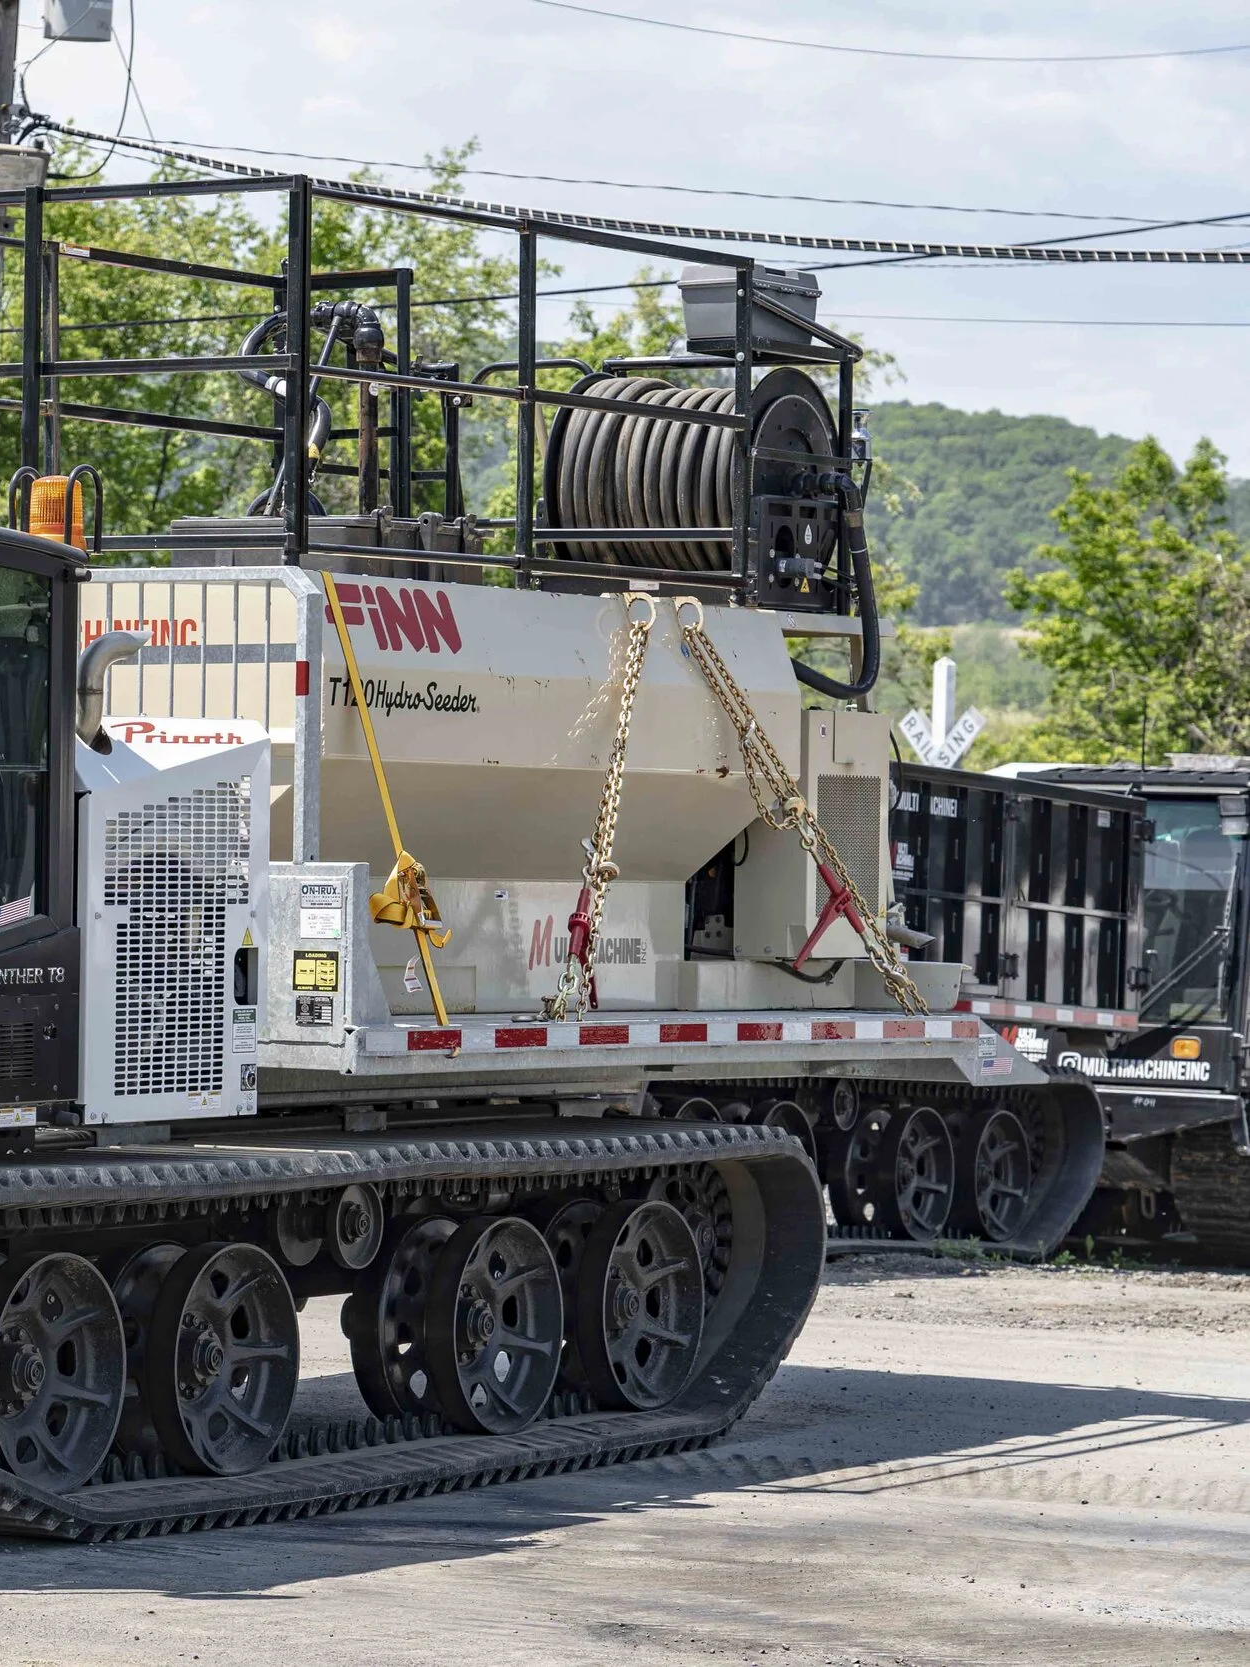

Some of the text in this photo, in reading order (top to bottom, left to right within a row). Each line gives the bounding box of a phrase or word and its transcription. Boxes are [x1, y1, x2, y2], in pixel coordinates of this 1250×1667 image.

[111, 721, 244, 744] Prinoth
[48, 967, 65, 983] T8
[1082, 1057, 1210, 1081] MULTIMACHINEINC
